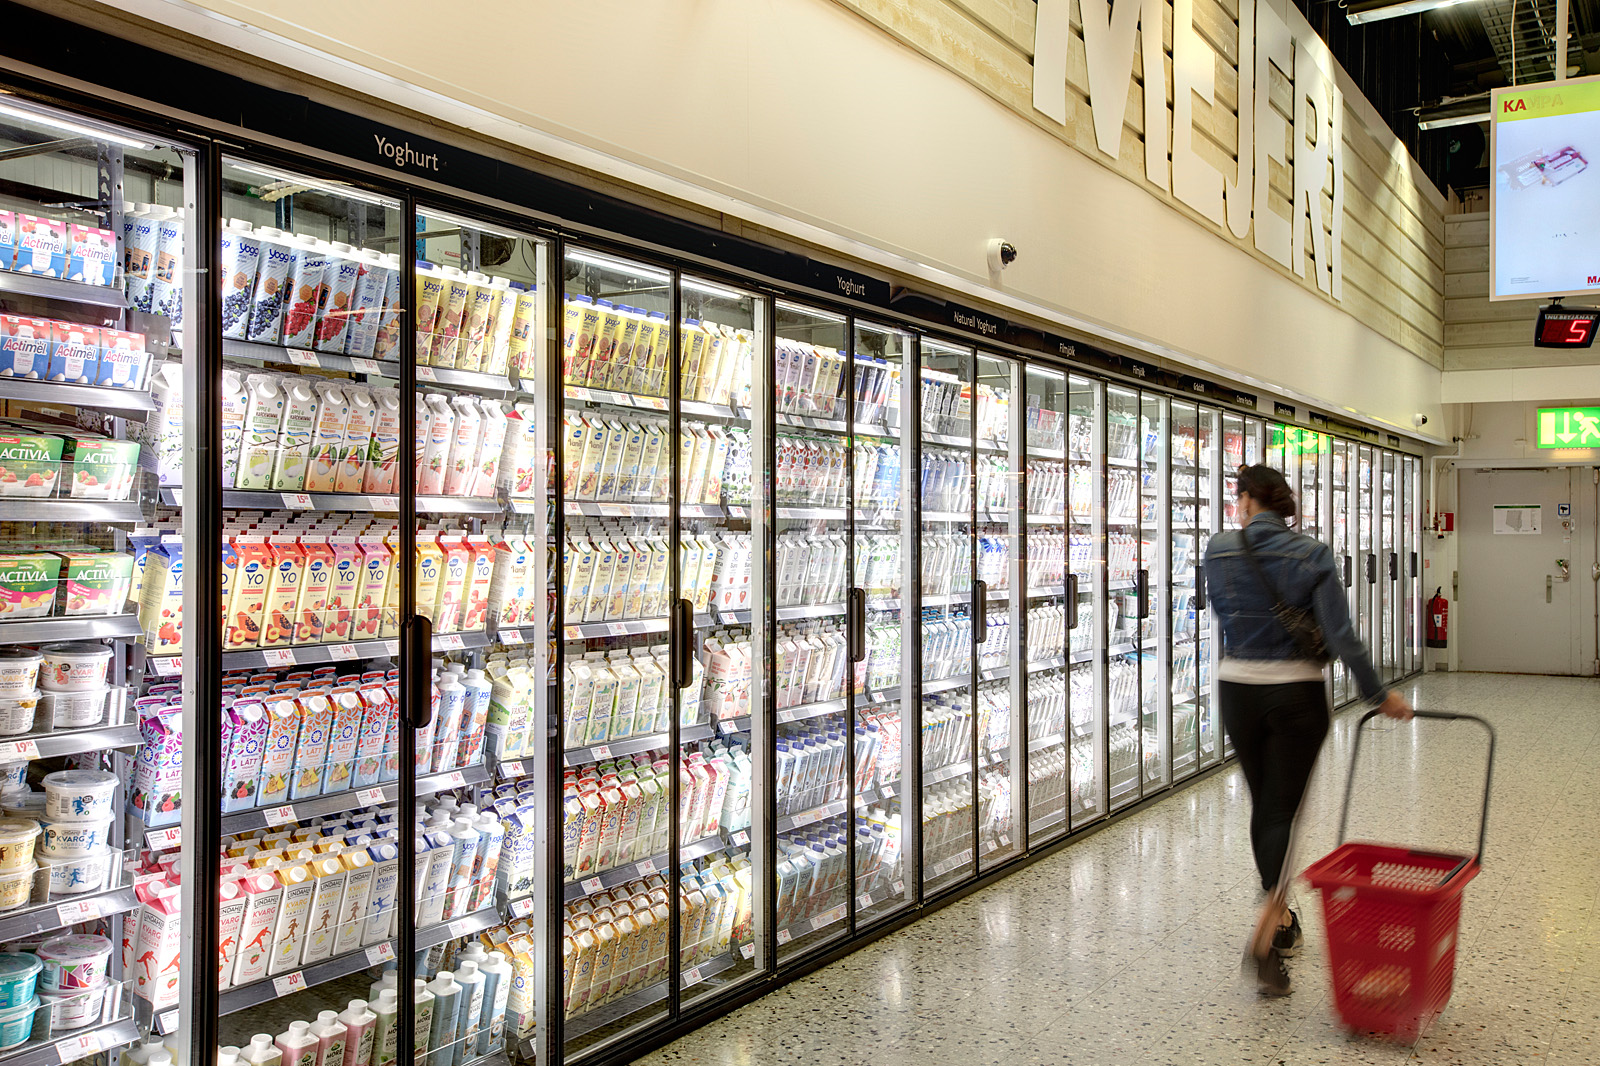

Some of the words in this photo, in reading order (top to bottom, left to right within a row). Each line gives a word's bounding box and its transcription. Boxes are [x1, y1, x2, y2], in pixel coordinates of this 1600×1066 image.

[374, 134, 438, 171] Yoghurt
[1033, 0, 1344, 302] MEJERI
[22, 235, 64, 254] Actimel
[240, 243, 259, 257] yogg
[74, 246, 112, 262] Actimel
[269, 249, 289, 263] yogg
[836, 276, 865, 296] Yoghurt
[954, 312, 976, 327] Naturell
[976, 318, 997, 334] Yoghurt
[1565, 320, 1592, 342] 5
[4, 338, 47, 355] Actimel
[56, 345, 96, 360] Actimel
[104, 350, 141, 365] Actimel
[0, 448, 50, 461] ACTIVIA
[82, 452, 128, 464] ACTIVIA
[0, 571, 48, 582] ACTIVIA
[76, 569, 122, 581] ACTIVIA
[312, 572, 327, 582] YO
[339, 571, 355, 582] YO
[369, 570, 384, 580] YO
[423, 568, 436, 578] YO
[450, 568, 462, 577] YO
[478, 567, 489, 576] YO
[247, 574, 264, 585] YO
[281, 572, 296, 583] YO
[367, 737, 381, 745] LÄTT
[273, 753, 289, 761] LÄTT
[306, 748, 322, 756] LÄTT
[241, 758, 258, 766] LÄTT
[139, 764, 153, 776] LÄTT
[166, 770, 182, 778] LÄT
[377, 874, 396, 884] KVARG
[348, 882, 368, 892] KVARG
[319, 890, 340, 900] KVARG
[286, 898, 308, 909] KVARG
[252, 907, 276, 918] KVARG
[123, 916, 136, 927] ARG
[220, 915, 240, 926] VARG
[142, 924, 161, 940] KVARG
